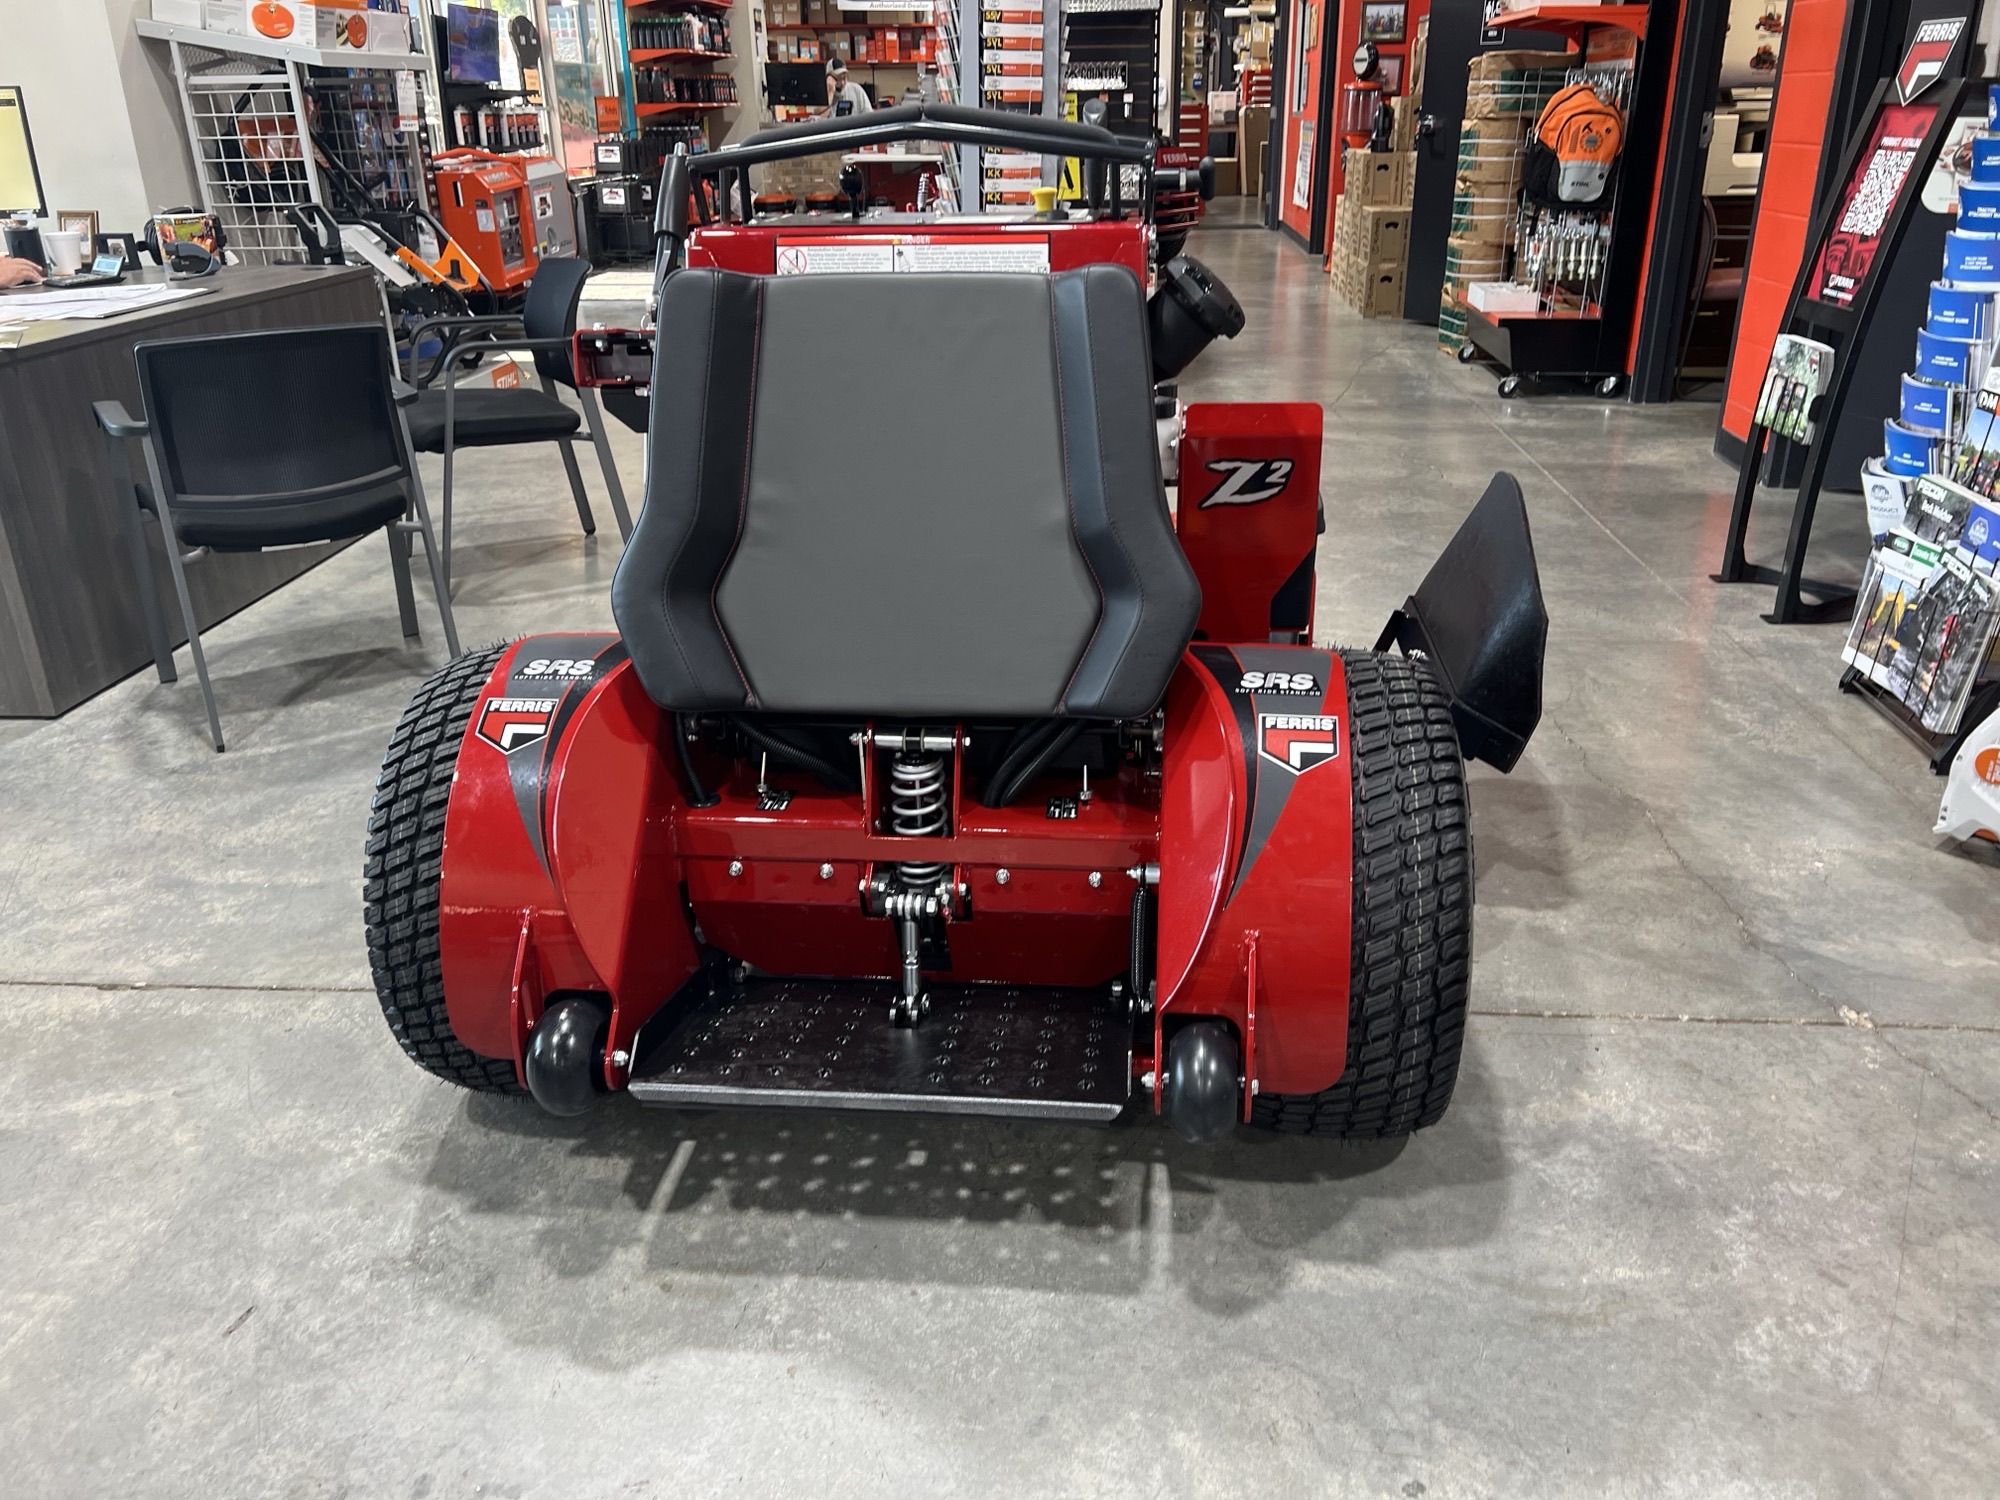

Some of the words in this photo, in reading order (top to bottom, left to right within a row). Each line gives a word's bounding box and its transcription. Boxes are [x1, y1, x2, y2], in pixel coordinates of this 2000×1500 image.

[869, 1, 907, 9] Authorized
[908, 1, 929, 9] Dealer
[1916, 22, 1961, 43] FERRIS
[1880, 136, 1902, 148] PRODUCT
[901, 236, 930, 244] DANGER
[1835, 275, 1854, 289] FERRIS
[496, 372, 517, 389] STIHL
[1916, 479, 1948, 503] FECON
[1940, 551, 1973, 584] FECON
[523, 659, 595, 675] SRS
[1240, 671, 1314, 690] SRS
[489, 700, 553, 712] FERRIS
[1265, 716, 1334, 730] FERRIS
